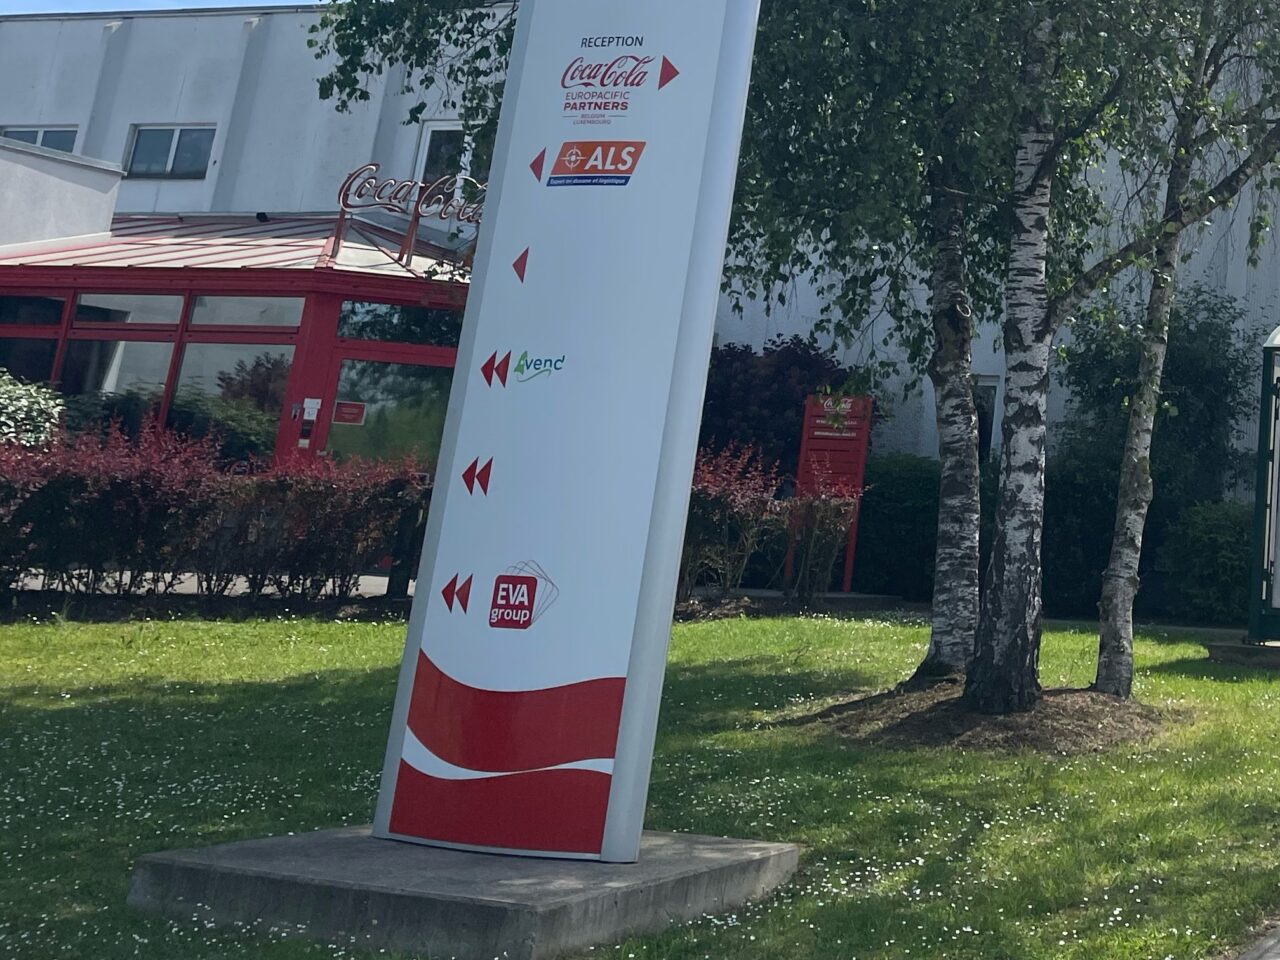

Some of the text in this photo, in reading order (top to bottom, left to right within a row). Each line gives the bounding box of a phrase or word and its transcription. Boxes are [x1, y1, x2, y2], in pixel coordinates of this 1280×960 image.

[580, 36, 644, 48] RECEPTION
[560, 55, 656, 88] Coca-Cola
[565, 91, 630, 101] EUROPACIFIC
[563, 101, 629, 111] PARTNERS
[583, 146, 636, 170] ALS
[513, 350, 565, 375] Avend
[497, 583, 529, 606] EVA
[490, 608, 530, 624] group
